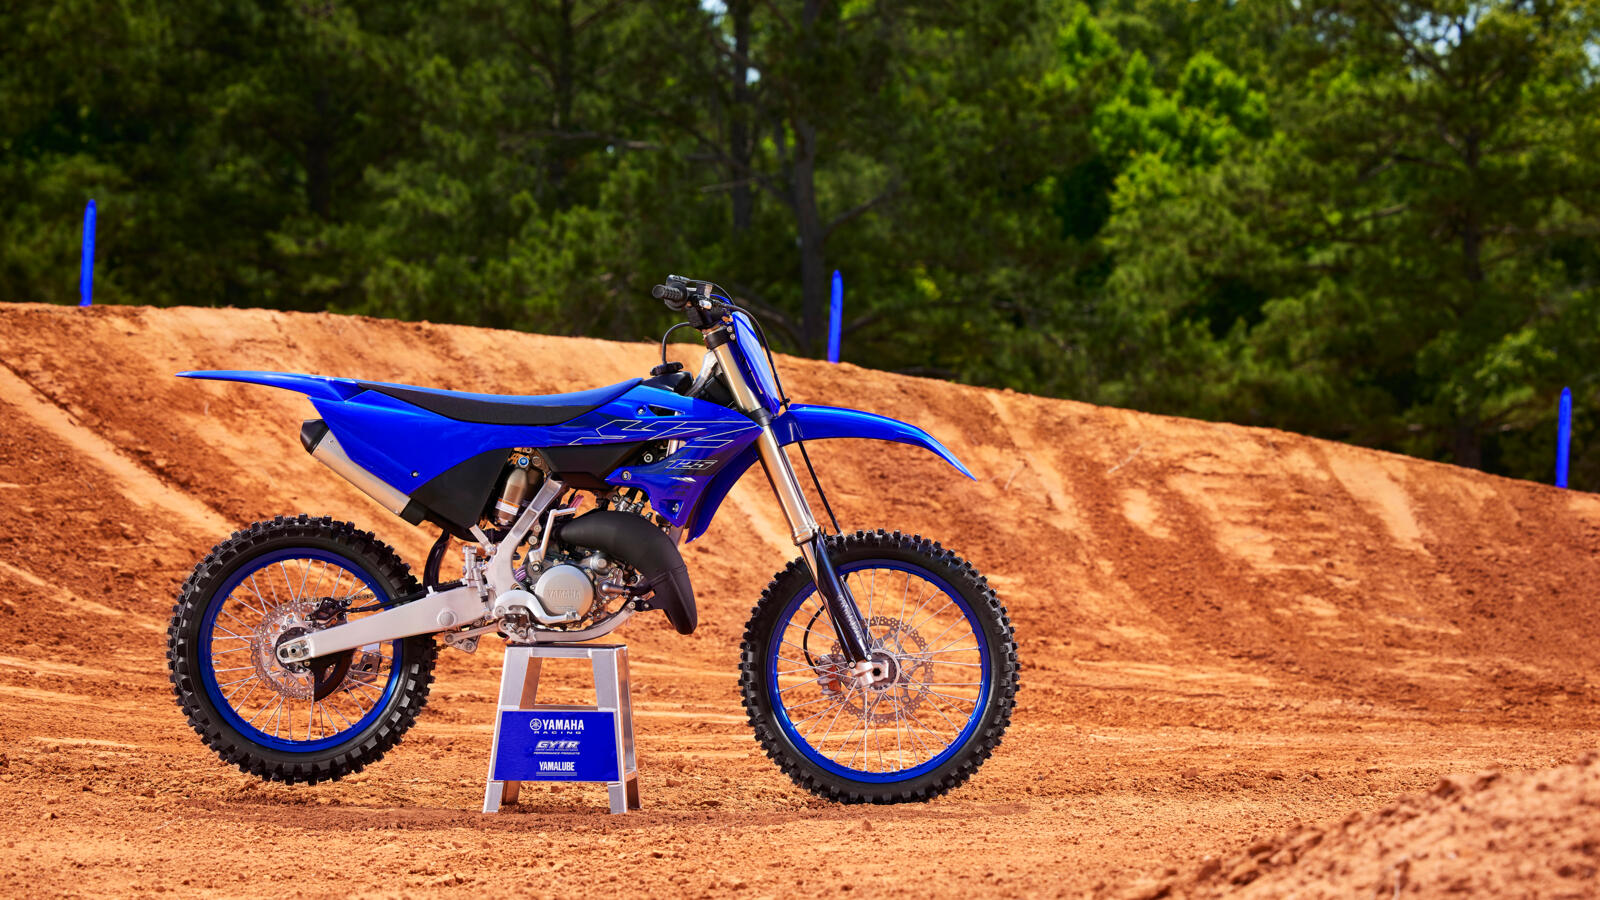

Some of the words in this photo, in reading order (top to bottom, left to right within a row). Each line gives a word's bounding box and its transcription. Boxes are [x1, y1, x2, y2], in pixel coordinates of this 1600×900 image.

[542, 719, 584, 731] YAMAHA
[535, 740, 580, 748] GYTR
[539, 761, 575, 771] YAMALUBE
